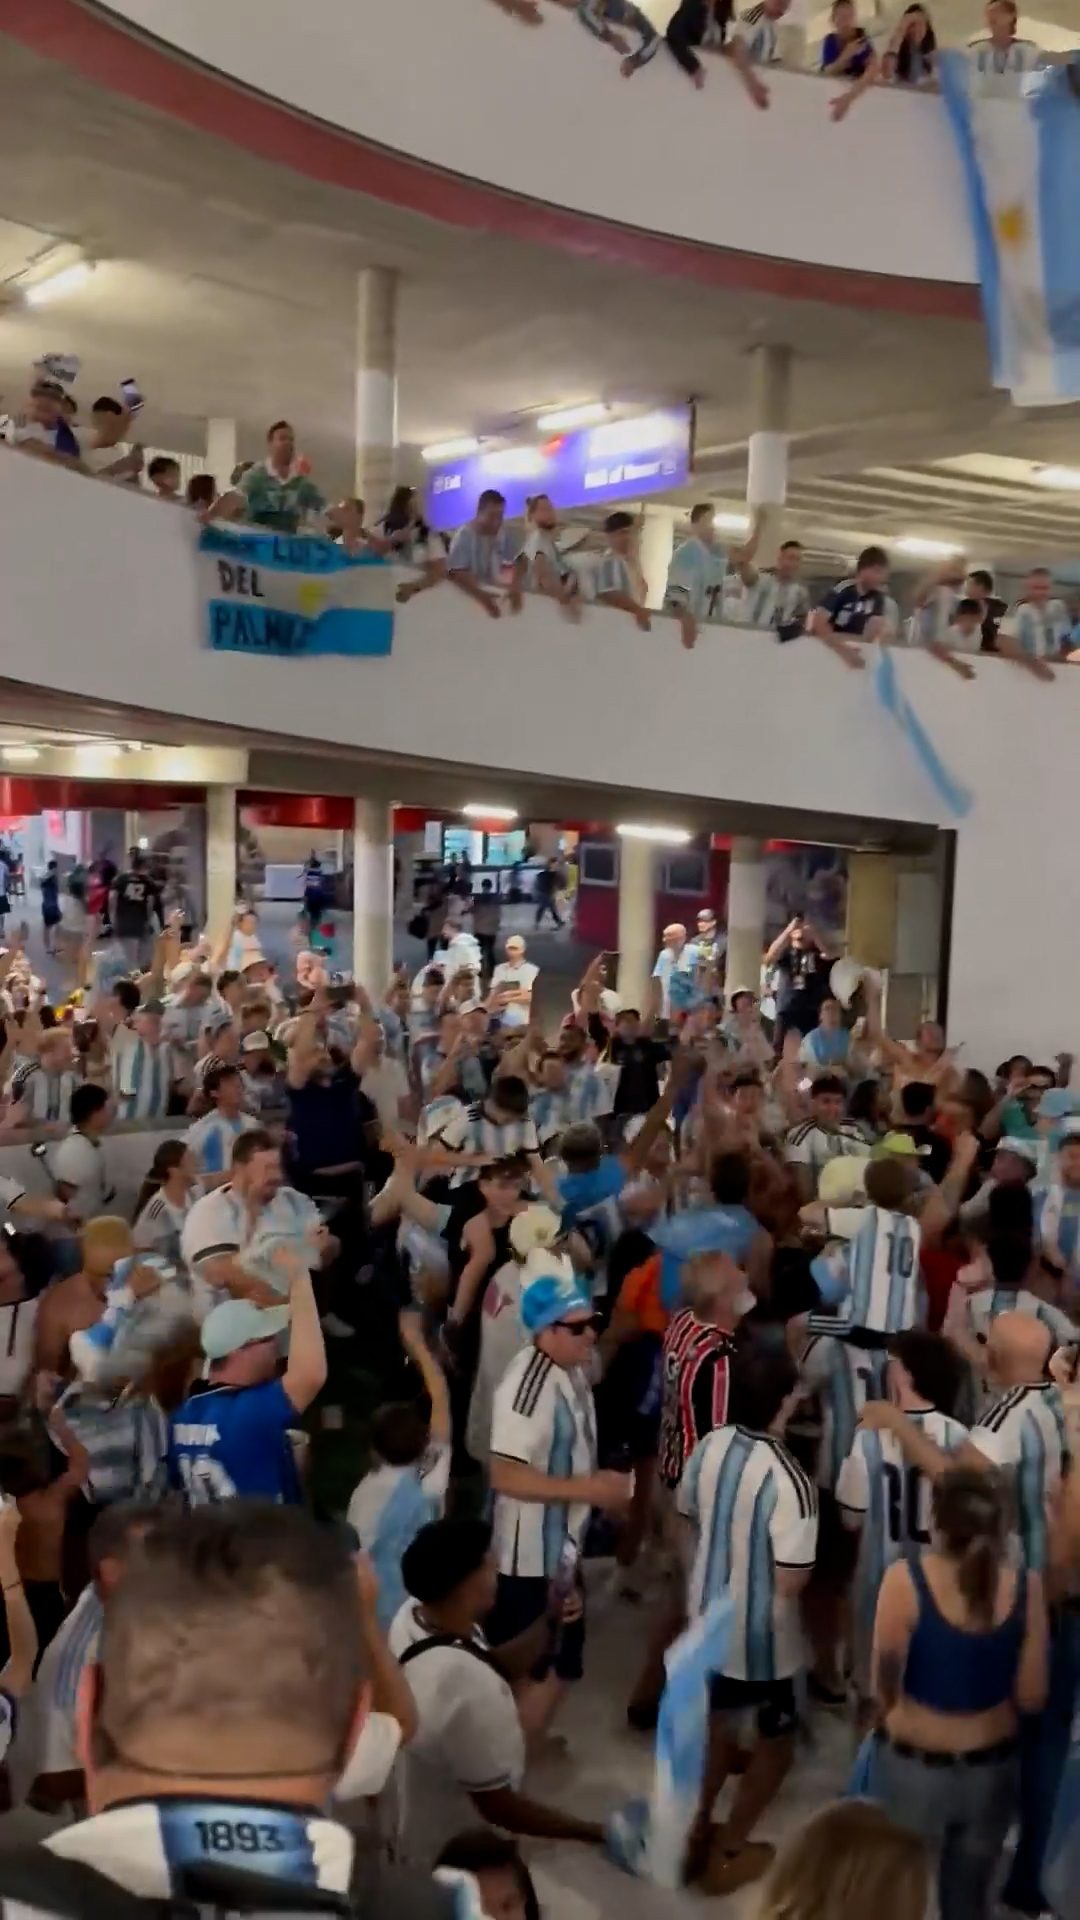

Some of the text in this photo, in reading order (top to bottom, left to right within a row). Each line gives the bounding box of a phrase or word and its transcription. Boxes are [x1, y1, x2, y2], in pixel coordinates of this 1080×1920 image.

[217, 559, 265, 597] DEL
[214, 604, 320, 652] PALM
[885, 1231, 914, 1279] 10
[194, 1820, 284, 1852] 1893
